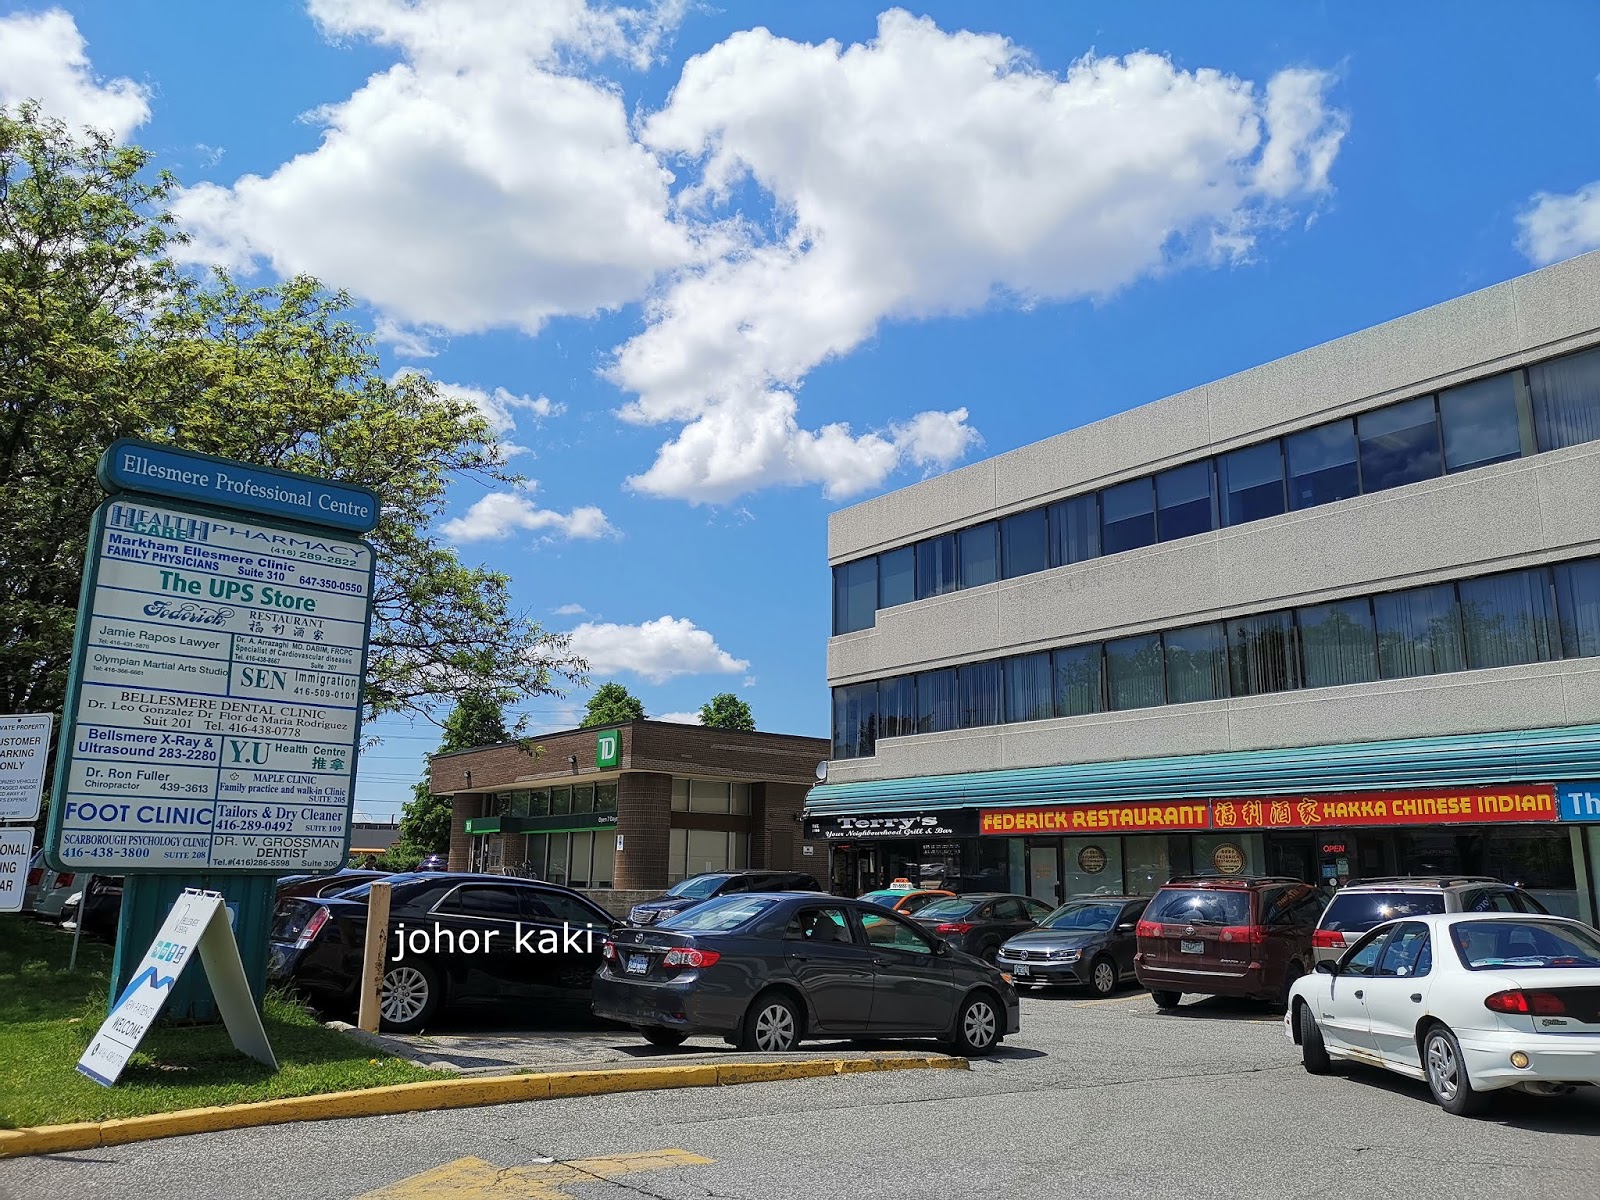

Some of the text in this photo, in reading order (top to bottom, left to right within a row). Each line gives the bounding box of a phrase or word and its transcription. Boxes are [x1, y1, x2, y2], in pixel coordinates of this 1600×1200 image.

[122, 454, 369, 518] Ellesmere Professional Centre
[134, 522, 188, 540] CARE
[212, 524, 366, 558] PHARMACY
[110, 533, 296, 572] Markham Ellesmere Clinic
[271, 547, 357, 566] (416) 289-2822
[107, 545, 362, 594] FAMILY PHYSICIANS Suite 310 647-350-0550
[160, 570, 316, 612] The UPS Store
[249, 610, 325, 628] RESTAURANT
[100, 625, 220, 650] Jamie Rapos Lawyer
[248, 620, 324, 641] 福利酒家
[236, 636, 246, 644] Dr.
[258, 638, 289, 650] Arrazaghi
[331, 648, 353, 656] FRCPC
[236, 644, 352, 664] Specialist of Cardiovascular diseases
[94, 654, 229, 676] Olympian Martial Arts Studio
[311, 662, 324, 670] Suite
[240, 666, 356, 690] SEN Immigration
[294, 686, 356, 700] 416-509-0101
[88, 699, 348, 731] Dr. Leo Gonzalez Dr Flor de Maria Rodriguez
[120, 692, 327, 720] BELLESMERE DENTAL CLINIC
[143, 716, 301, 738] Suit 201 Tel. 416-438-0778
[88, 728, 214, 750] Bellsmere X-Ray &
[598, 737, 616, 760] TD
[78, 742, 216, 762] Ultrasound 283-2280
[230, 740, 272, 765] Y.U
[275, 743, 346, 757] Health Centre
[0, 762, 25, 770] ONLY
[312, 756, 345, 770] 推拿
[86, 766, 170, 781] Dr. Ron Fuller
[253, 773, 317, 785] MAPLE CLINIC
[84, 780, 208, 794] Chiropractor 439-3613
[220, 782, 346, 796] Family practice and walk-in Clinic
[308, 795, 346, 804] SUITE 205
[1322, 794, 1552, 818] HAKKA CHINESE INDIAN
[65, 802, 214, 825] FOOT CLINIC
[218, 804, 343, 822] Tailors & Dry Cleaner
[984, 805, 1206, 830] FEDERICK RESTAURANT
[1214, 798, 1321, 826] 福利酒家
[215, 820, 342, 833] 416-289-0492 SUITE 109
[825, 830, 844, 838] Your
[846, 828, 902, 838] Neighbourhood
[904, 828, 924, 836] Grill
[934, 826, 953, 834] Bar
[837, 816, 938, 829] Terry's
[0, 844, 26, 856] ONAL
[64, 834, 210, 848] SCARBOROUGH PSYCHOLOGY CLINIC
[214, 836, 340, 849] DR. W. GROSSMAN
[1323, 845, 1345, 853] OPEN
[62, 847, 150, 858] 416-438-3800
[191, 851, 206, 859] 208
[256, 848, 308, 858] DENTIST
[112, 1016, 144, 1040] WELCOME
